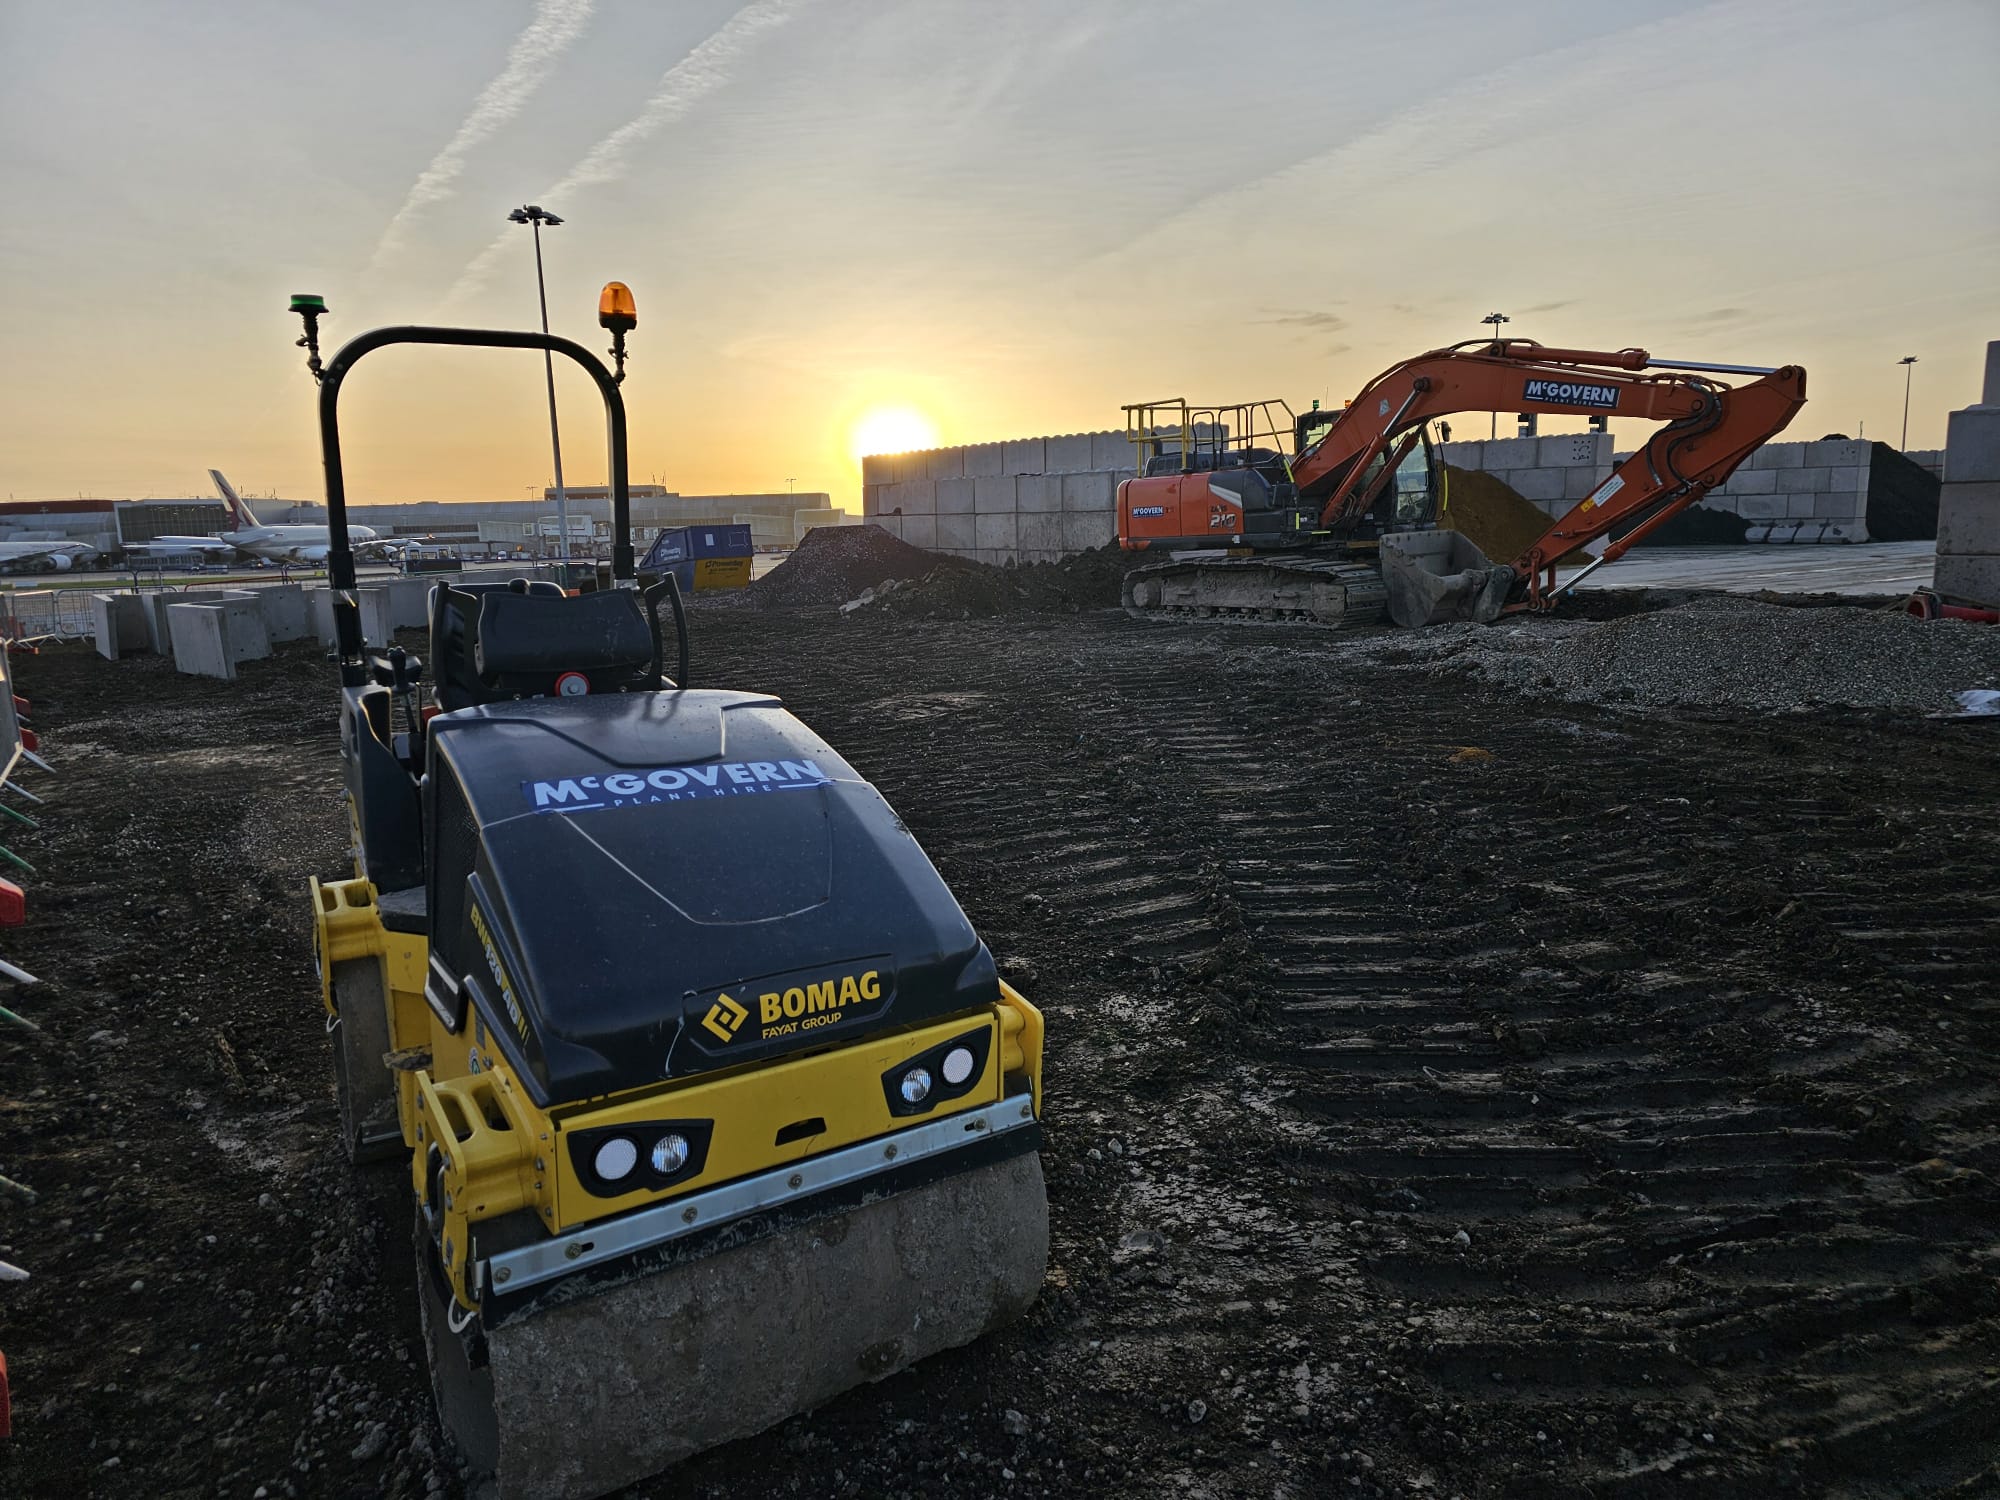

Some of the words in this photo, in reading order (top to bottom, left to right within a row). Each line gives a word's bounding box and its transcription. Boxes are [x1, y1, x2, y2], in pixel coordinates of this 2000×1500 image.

[1527, 381, 1616, 402] McGOVERN
[1210, 513, 1237, 528] 210
[533, 759, 824, 807] McGOVERN
[614, 791, 697, 807] PLANT
[714, 784, 772, 797] HIRE
[759, 970, 881, 1024] BOMAG
[762, 1022, 798, 1040] FAYAT
[801, 1012, 842, 1030] GROUP
